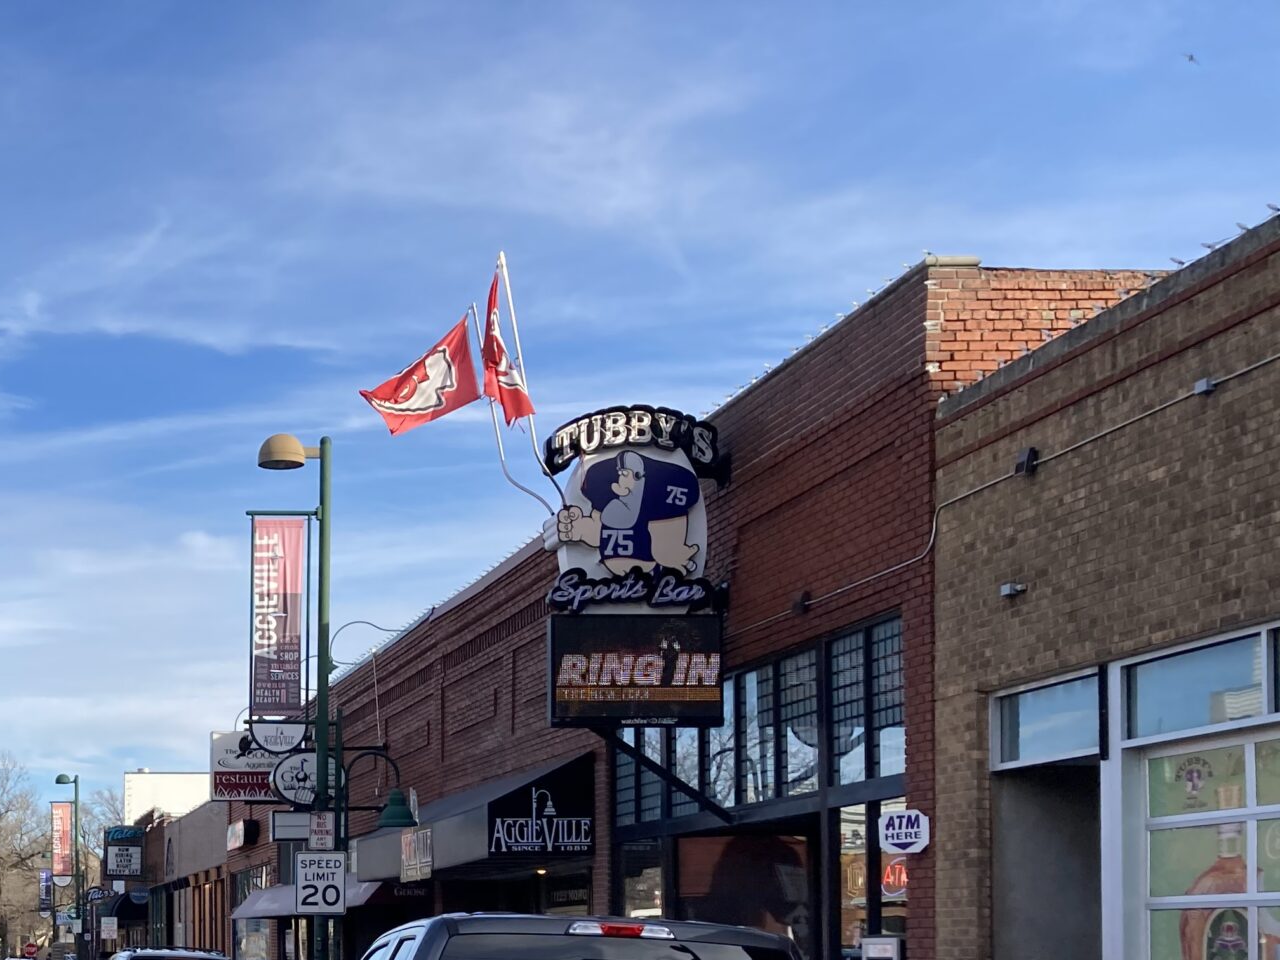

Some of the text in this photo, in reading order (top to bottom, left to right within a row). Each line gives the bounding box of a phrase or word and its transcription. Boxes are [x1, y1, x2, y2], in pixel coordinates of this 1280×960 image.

[553, 411, 713, 464] TUBBY'S
[666, 486, 688, 506] 75
[602, 530, 634, 556] 75
[253, 532, 279, 660] AGGIEVILLE
[552, 573, 706, 609] Sports Bar
[280, 652, 299, 660] SHOP
[270, 672, 299, 680] SERVICES
[556, 653, 720, 686] RING IN
[256, 689, 280, 697] HEALTH
[256, 696, 280, 704] BEAUTY
[885, 814, 920, 831] ATM
[490, 818, 592, 852] AGGIEVILLE
[885, 831, 922, 841] HERE
[301, 860, 342, 869] SPEED
[305, 872, 336, 881] LIMIT
[301, 884, 340, 907] 20
